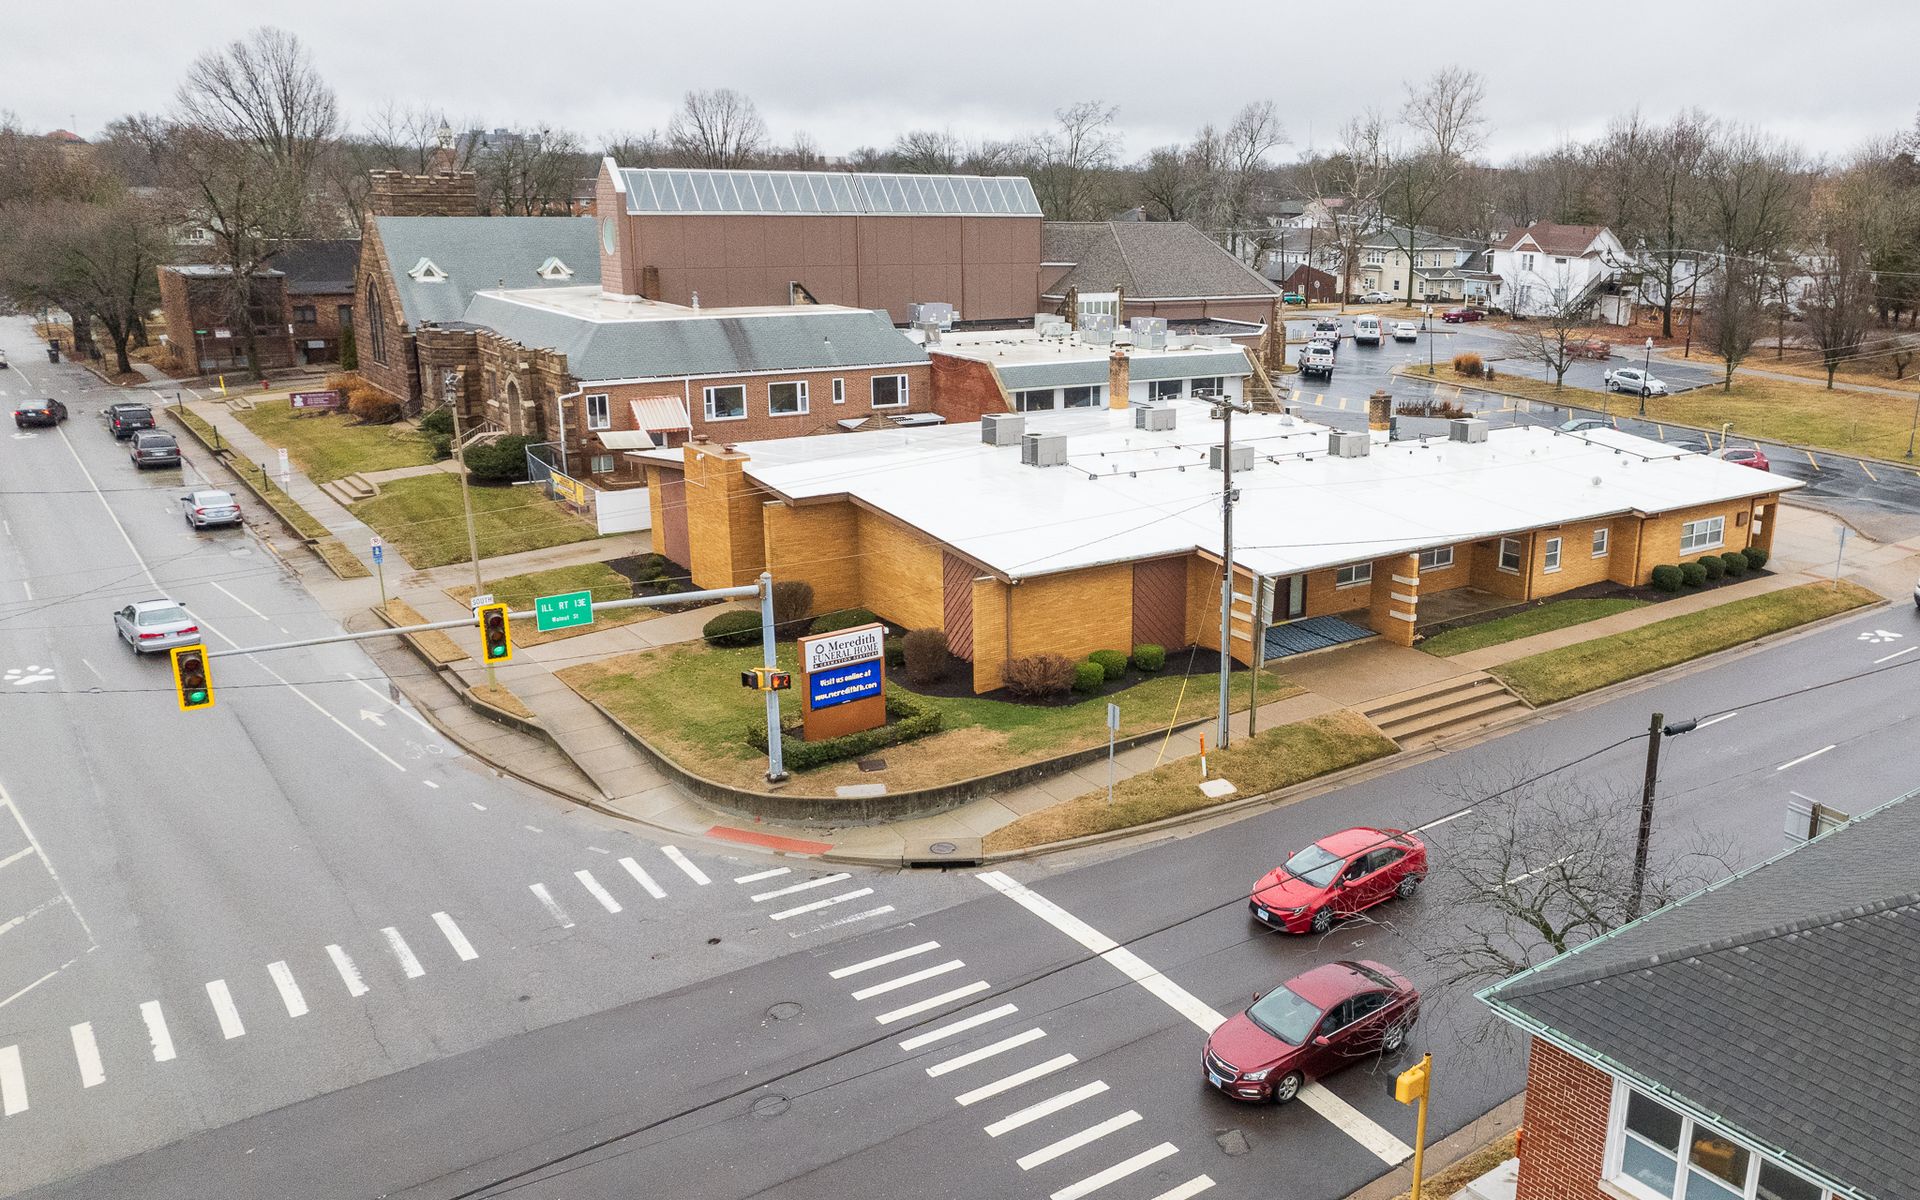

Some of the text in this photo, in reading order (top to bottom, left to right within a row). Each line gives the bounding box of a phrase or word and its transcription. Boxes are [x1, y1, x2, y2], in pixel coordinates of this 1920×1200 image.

[472, 596, 492, 605] SOUTH
[541, 599, 586, 612] ILL RT 13E
[828, 633, 875, 651] Meredith
[813, 643, 878, 663] FUNERAL HOME
[820, 678, 834, 687] Visit
[845, 673, 864, 681] online
